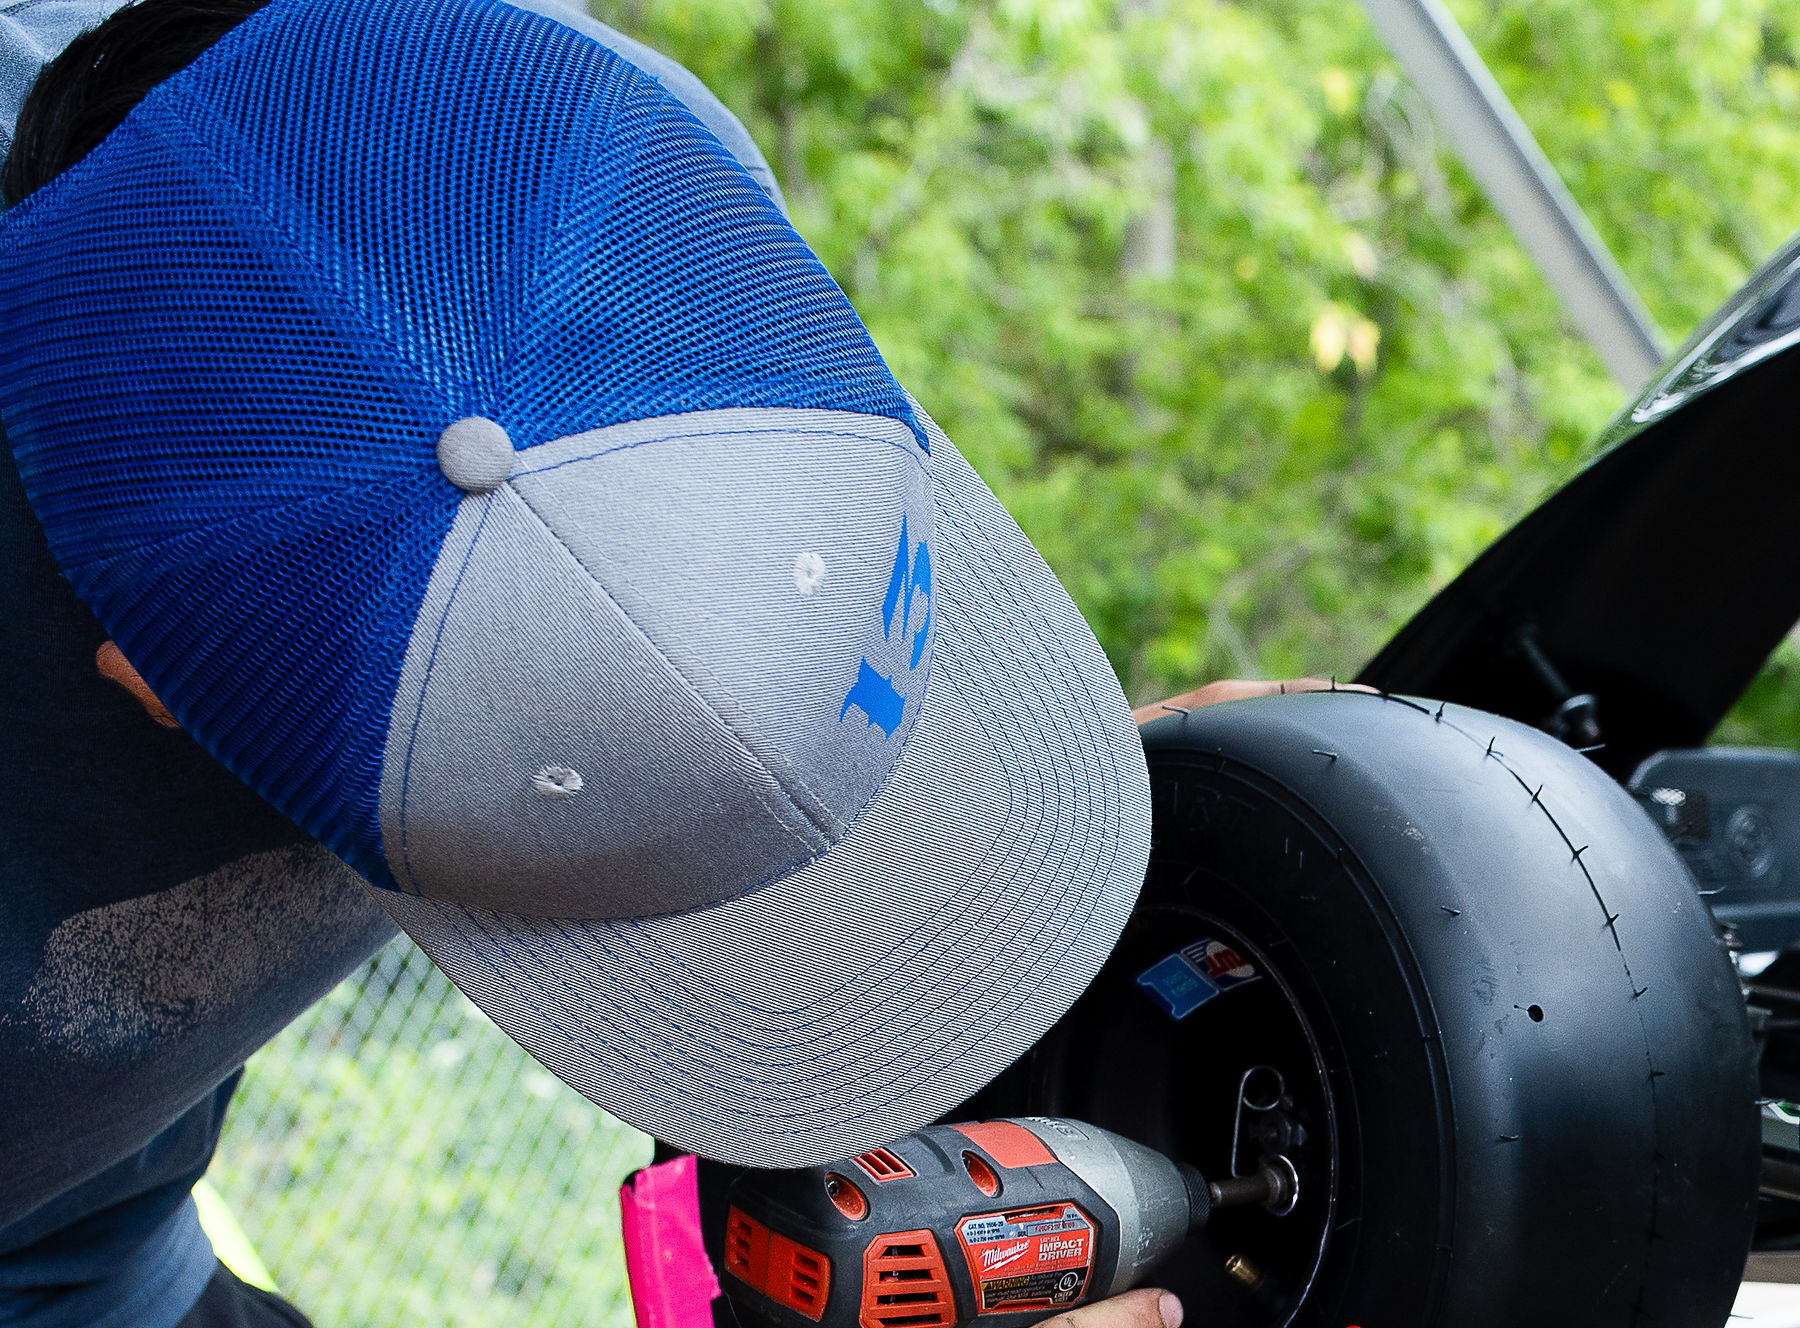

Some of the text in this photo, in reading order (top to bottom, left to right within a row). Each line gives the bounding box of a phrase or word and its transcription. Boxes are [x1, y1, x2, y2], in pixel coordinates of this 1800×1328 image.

[1039, 1238, 1085, 1253] IMPACT
[980, 1240, 1030, 1267] Milwaukee
[1038, 1247, 1083, 1262] DRIVER
